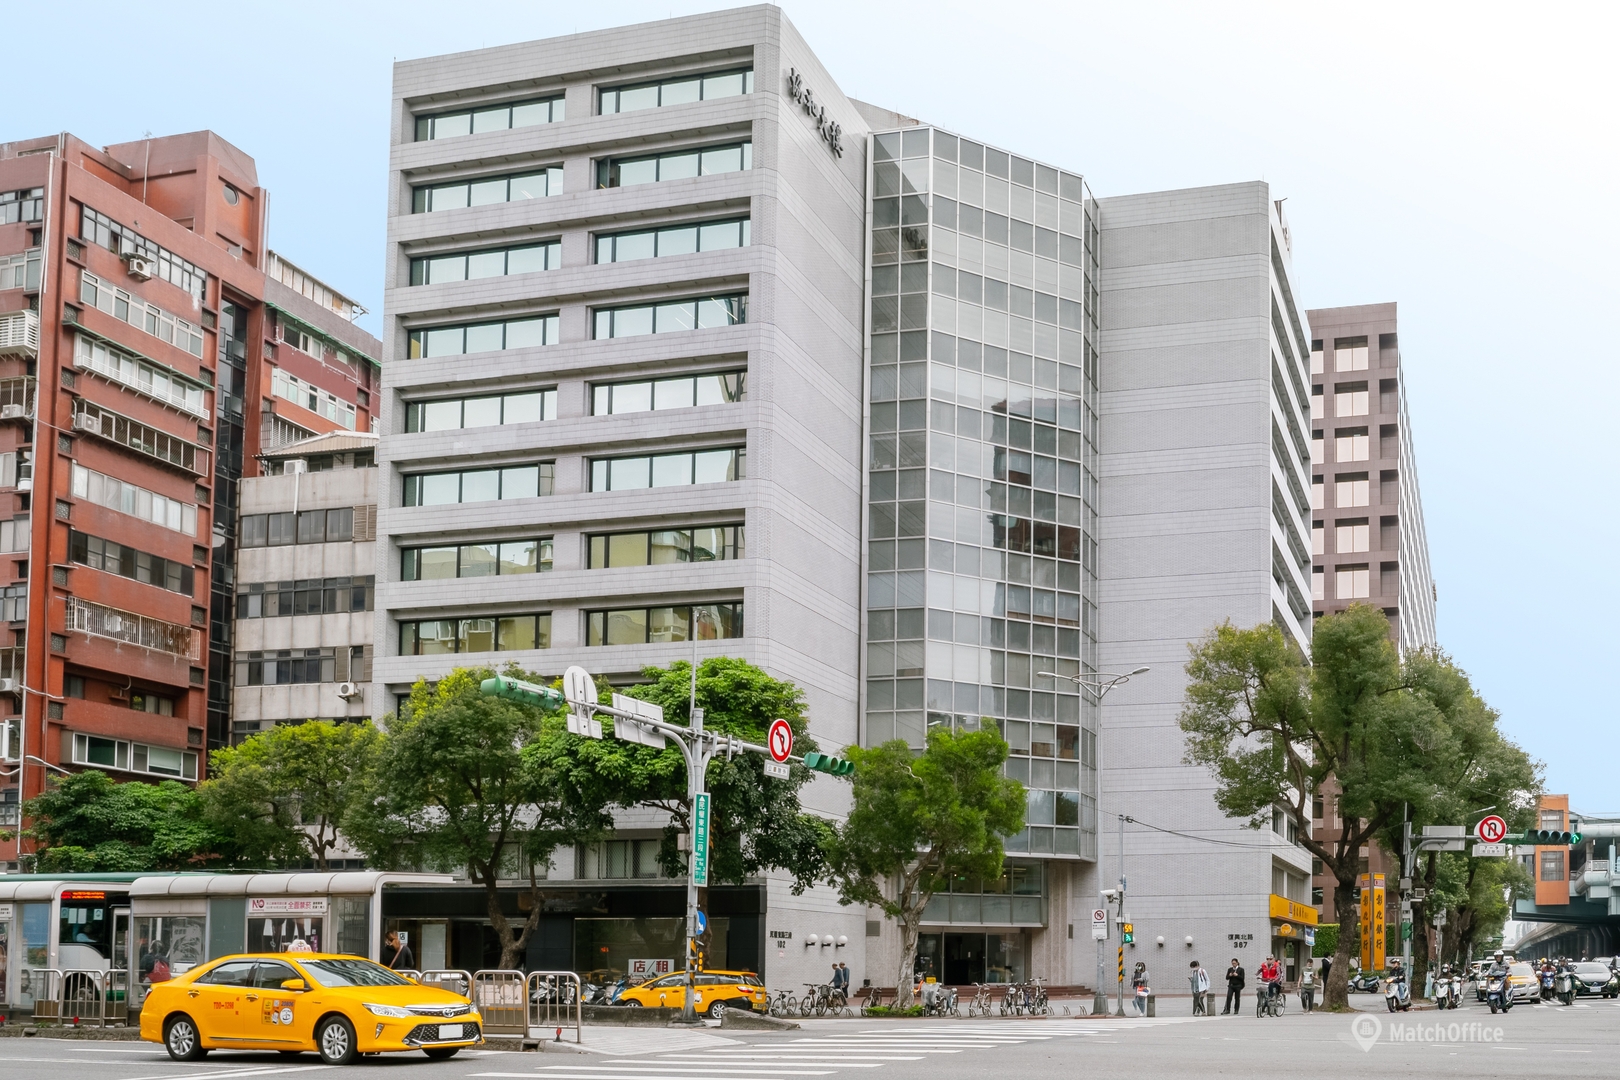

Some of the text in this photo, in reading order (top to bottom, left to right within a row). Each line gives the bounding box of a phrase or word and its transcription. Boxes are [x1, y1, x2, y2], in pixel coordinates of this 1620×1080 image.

[698, 801, 706, 852] 民權東路三段
[1227, 933, 1254, 941] 復興北路
[777, 940, 786, 949] 102
[1233, 941, 1248, 949] 367
